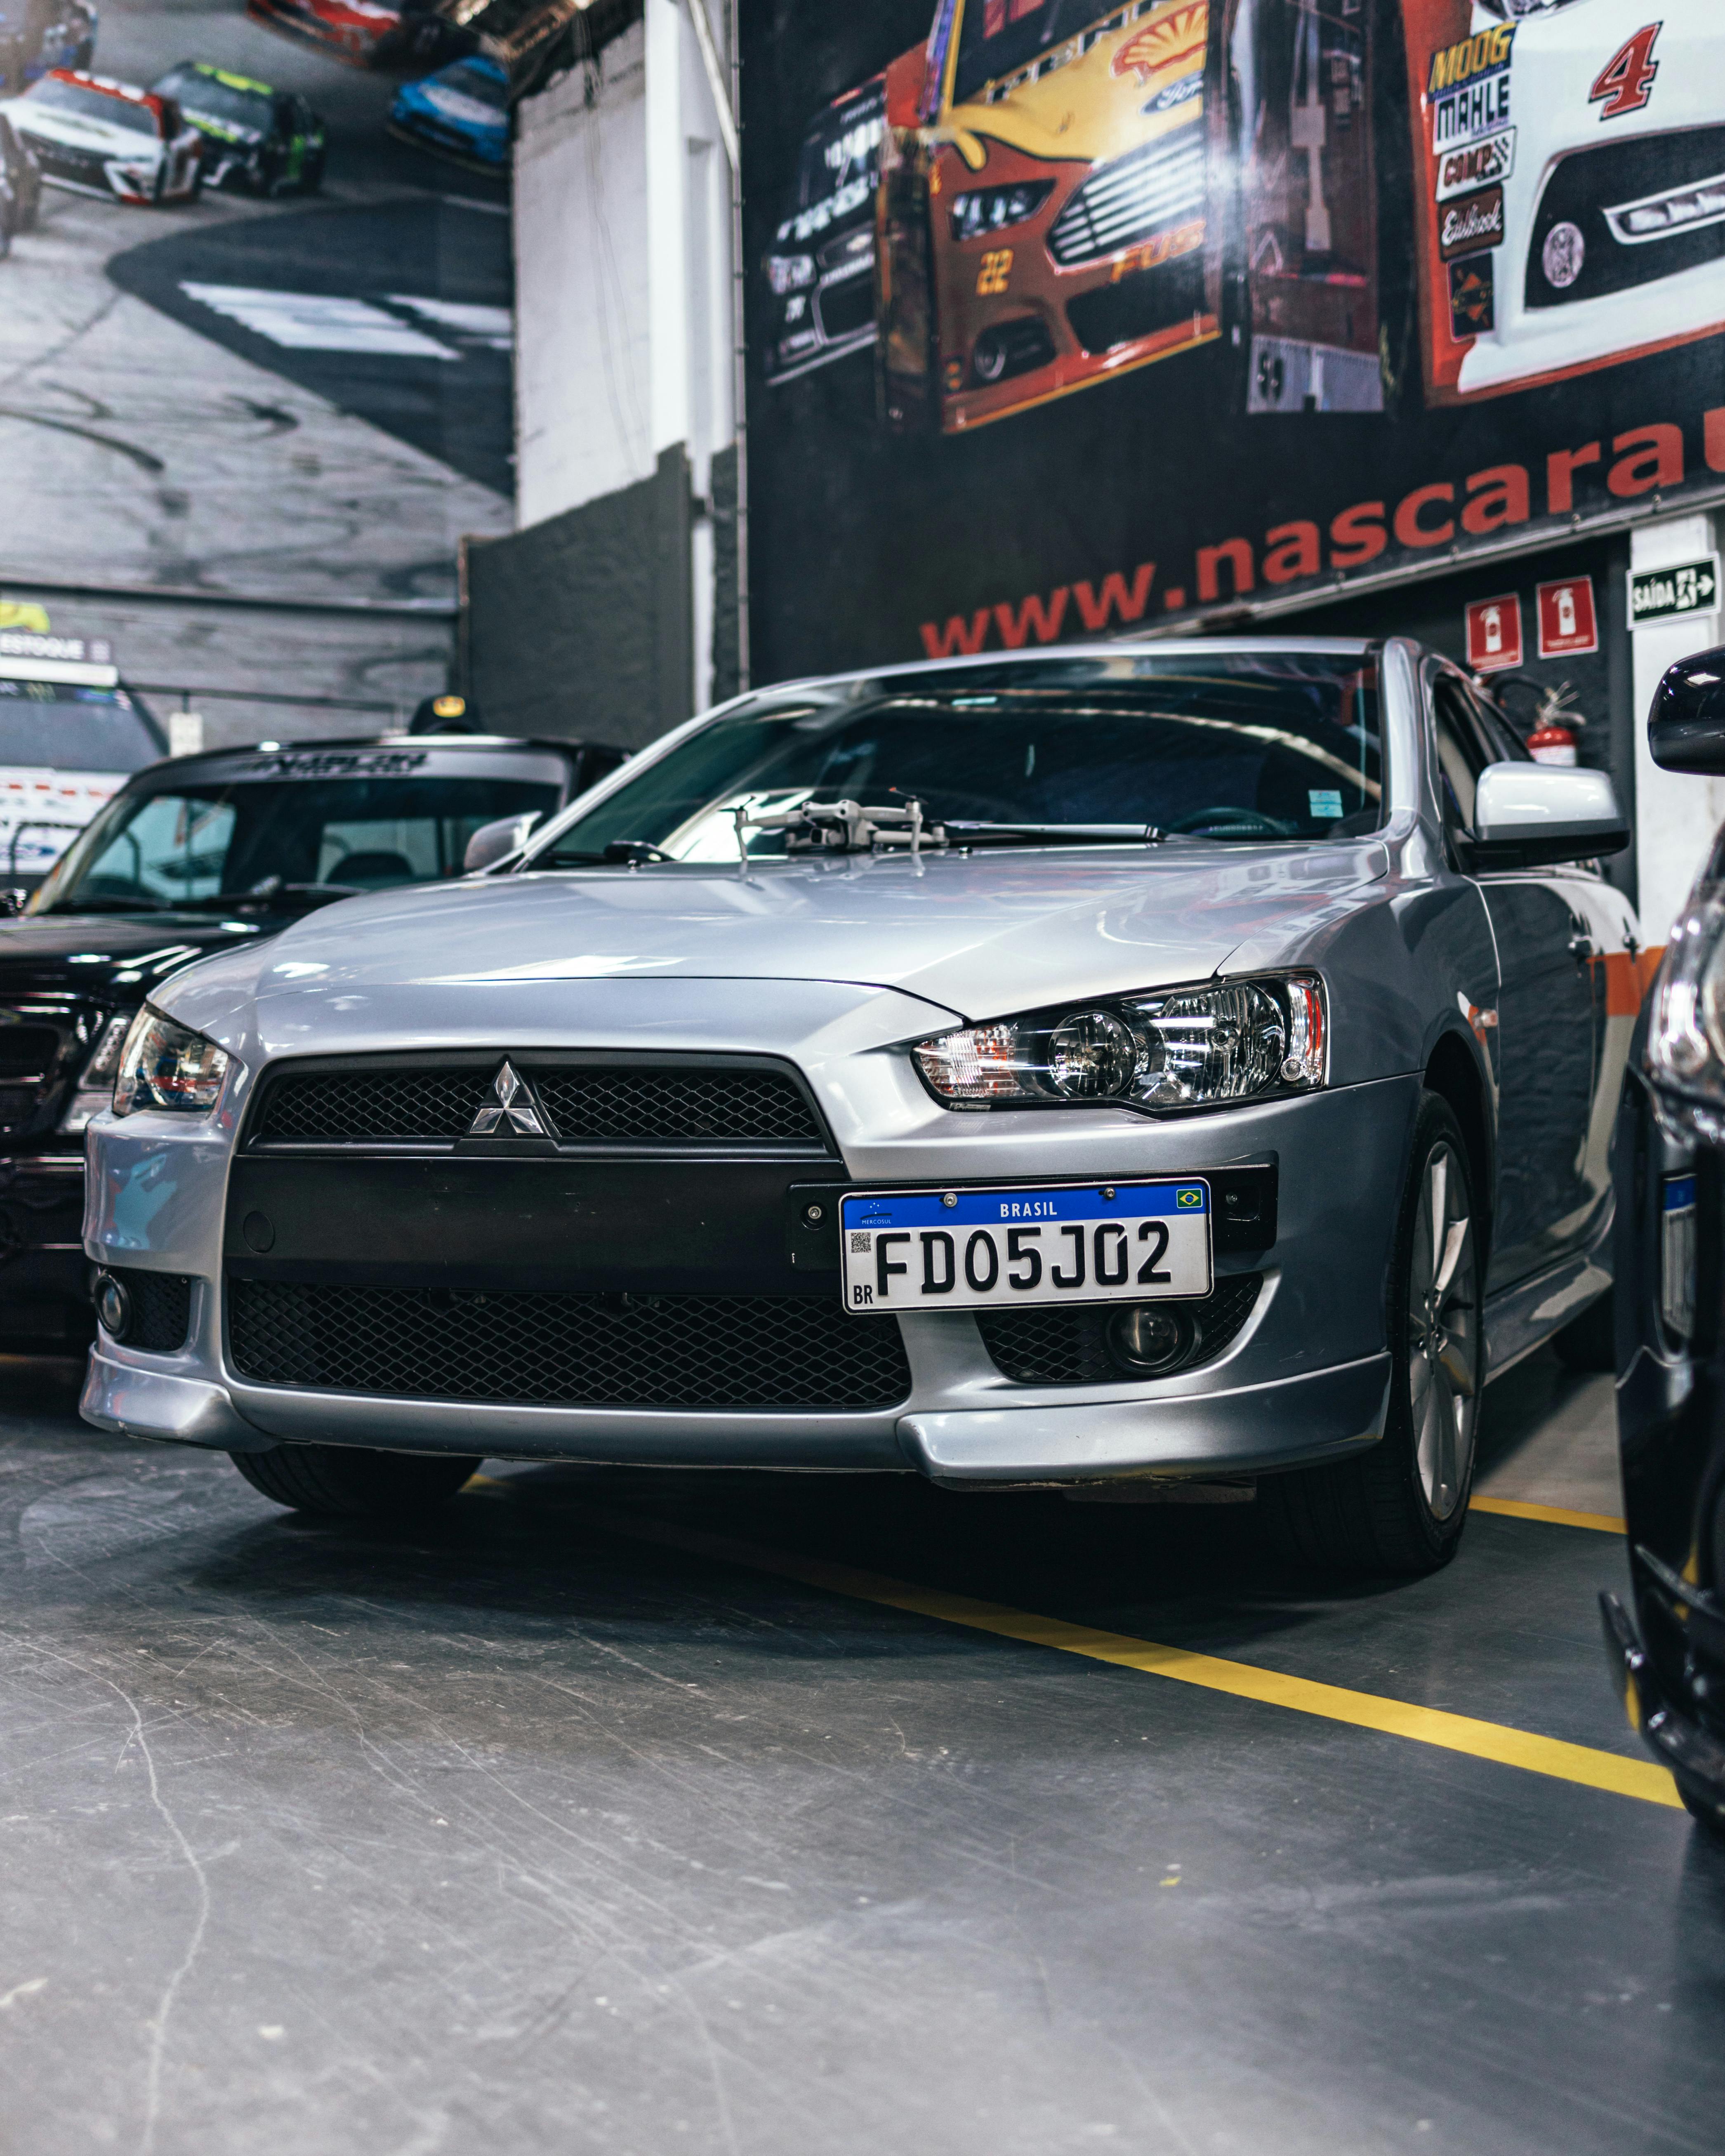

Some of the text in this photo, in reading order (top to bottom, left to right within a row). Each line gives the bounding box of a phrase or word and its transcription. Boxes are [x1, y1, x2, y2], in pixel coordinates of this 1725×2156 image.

[1428, 21, 1518, 93] MOOG
[1588, 19, 1664, 121] 4
[1437, 74, 1509, 141] MAHLE
[976, 249, 1014, 296] 22
[1634, 577, 1675, 613] SAÍDA
[1000, 1201, 1058, 1217] BRASIL
[853, 1284, 873, 1305] BR
